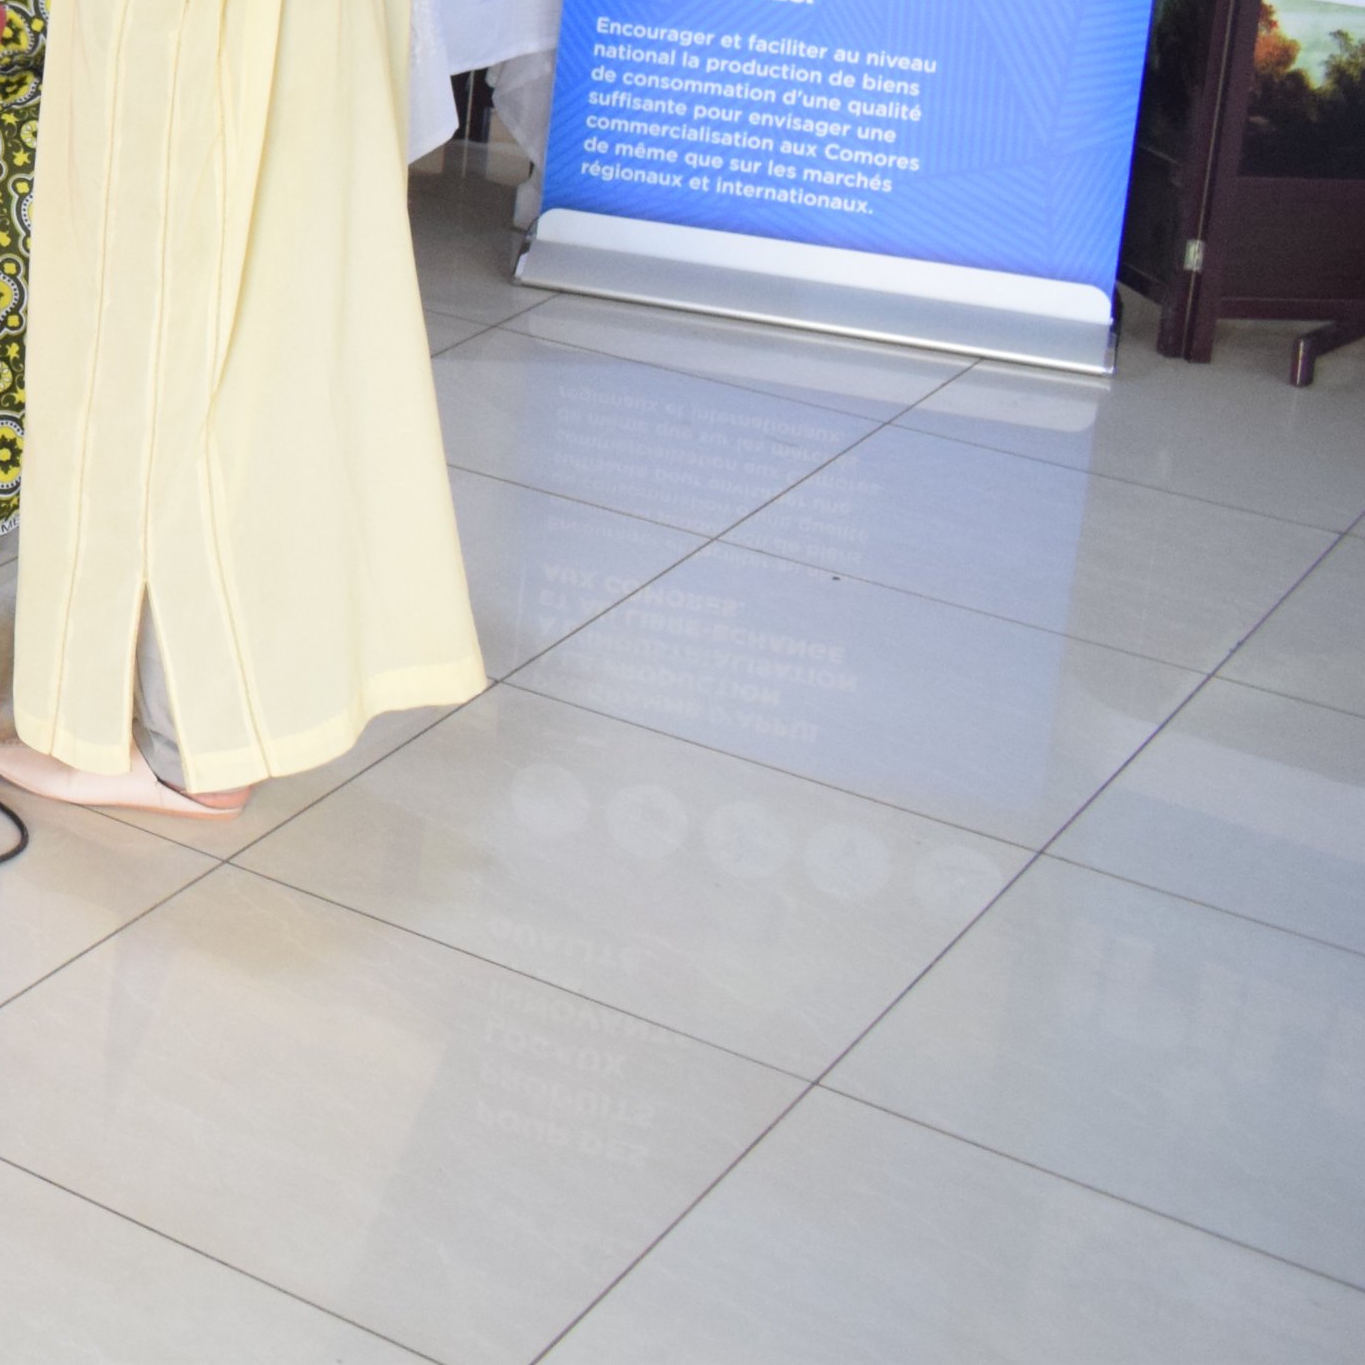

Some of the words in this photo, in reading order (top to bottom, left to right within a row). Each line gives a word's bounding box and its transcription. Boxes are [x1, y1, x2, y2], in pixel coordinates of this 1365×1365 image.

[593, 41, 676, 66] national
[682, 52, 700, 69] la
[706, 57, 822, 84] production
[829, 70, 855, 88] de
[862, 74, 920, 96] biens
[596, 16, 715, 46] Encourager
[720, 34, 741, 49] et
[748, 35, 828, 59] faciliter
[833, 48, 859, 65] au
[866, 50, 937, 75] niveau
[588, 91, 687, 116] suffisante
[693, 105, 742, 123] pour
[748, 112, 851, 136] envisager
[857, 126, 897, 144] une
[590, 66, 616, 83] de
[623, 71, 776, 102] consommation
[782, 89, 841, 111] d'une
[847, 99, 922, 122] qualité
[583, 137, 609, 154] de
[615, 142, 678, 164] même
[684, 152, 723, 170] que
[730, 158, 762, 174] sur
[768, 161, 796, 180] les
[803, 168, 893, 194] marchés
[585, 114, 774, 151] commercialisation
[780, 139, 816, 157] aux
[824, 144, 920, 172] Comores
[580, 160, 682, 188] régionaux
[688, 177, 710, 192] et
[716, 178, 873, 214] internationaux.
